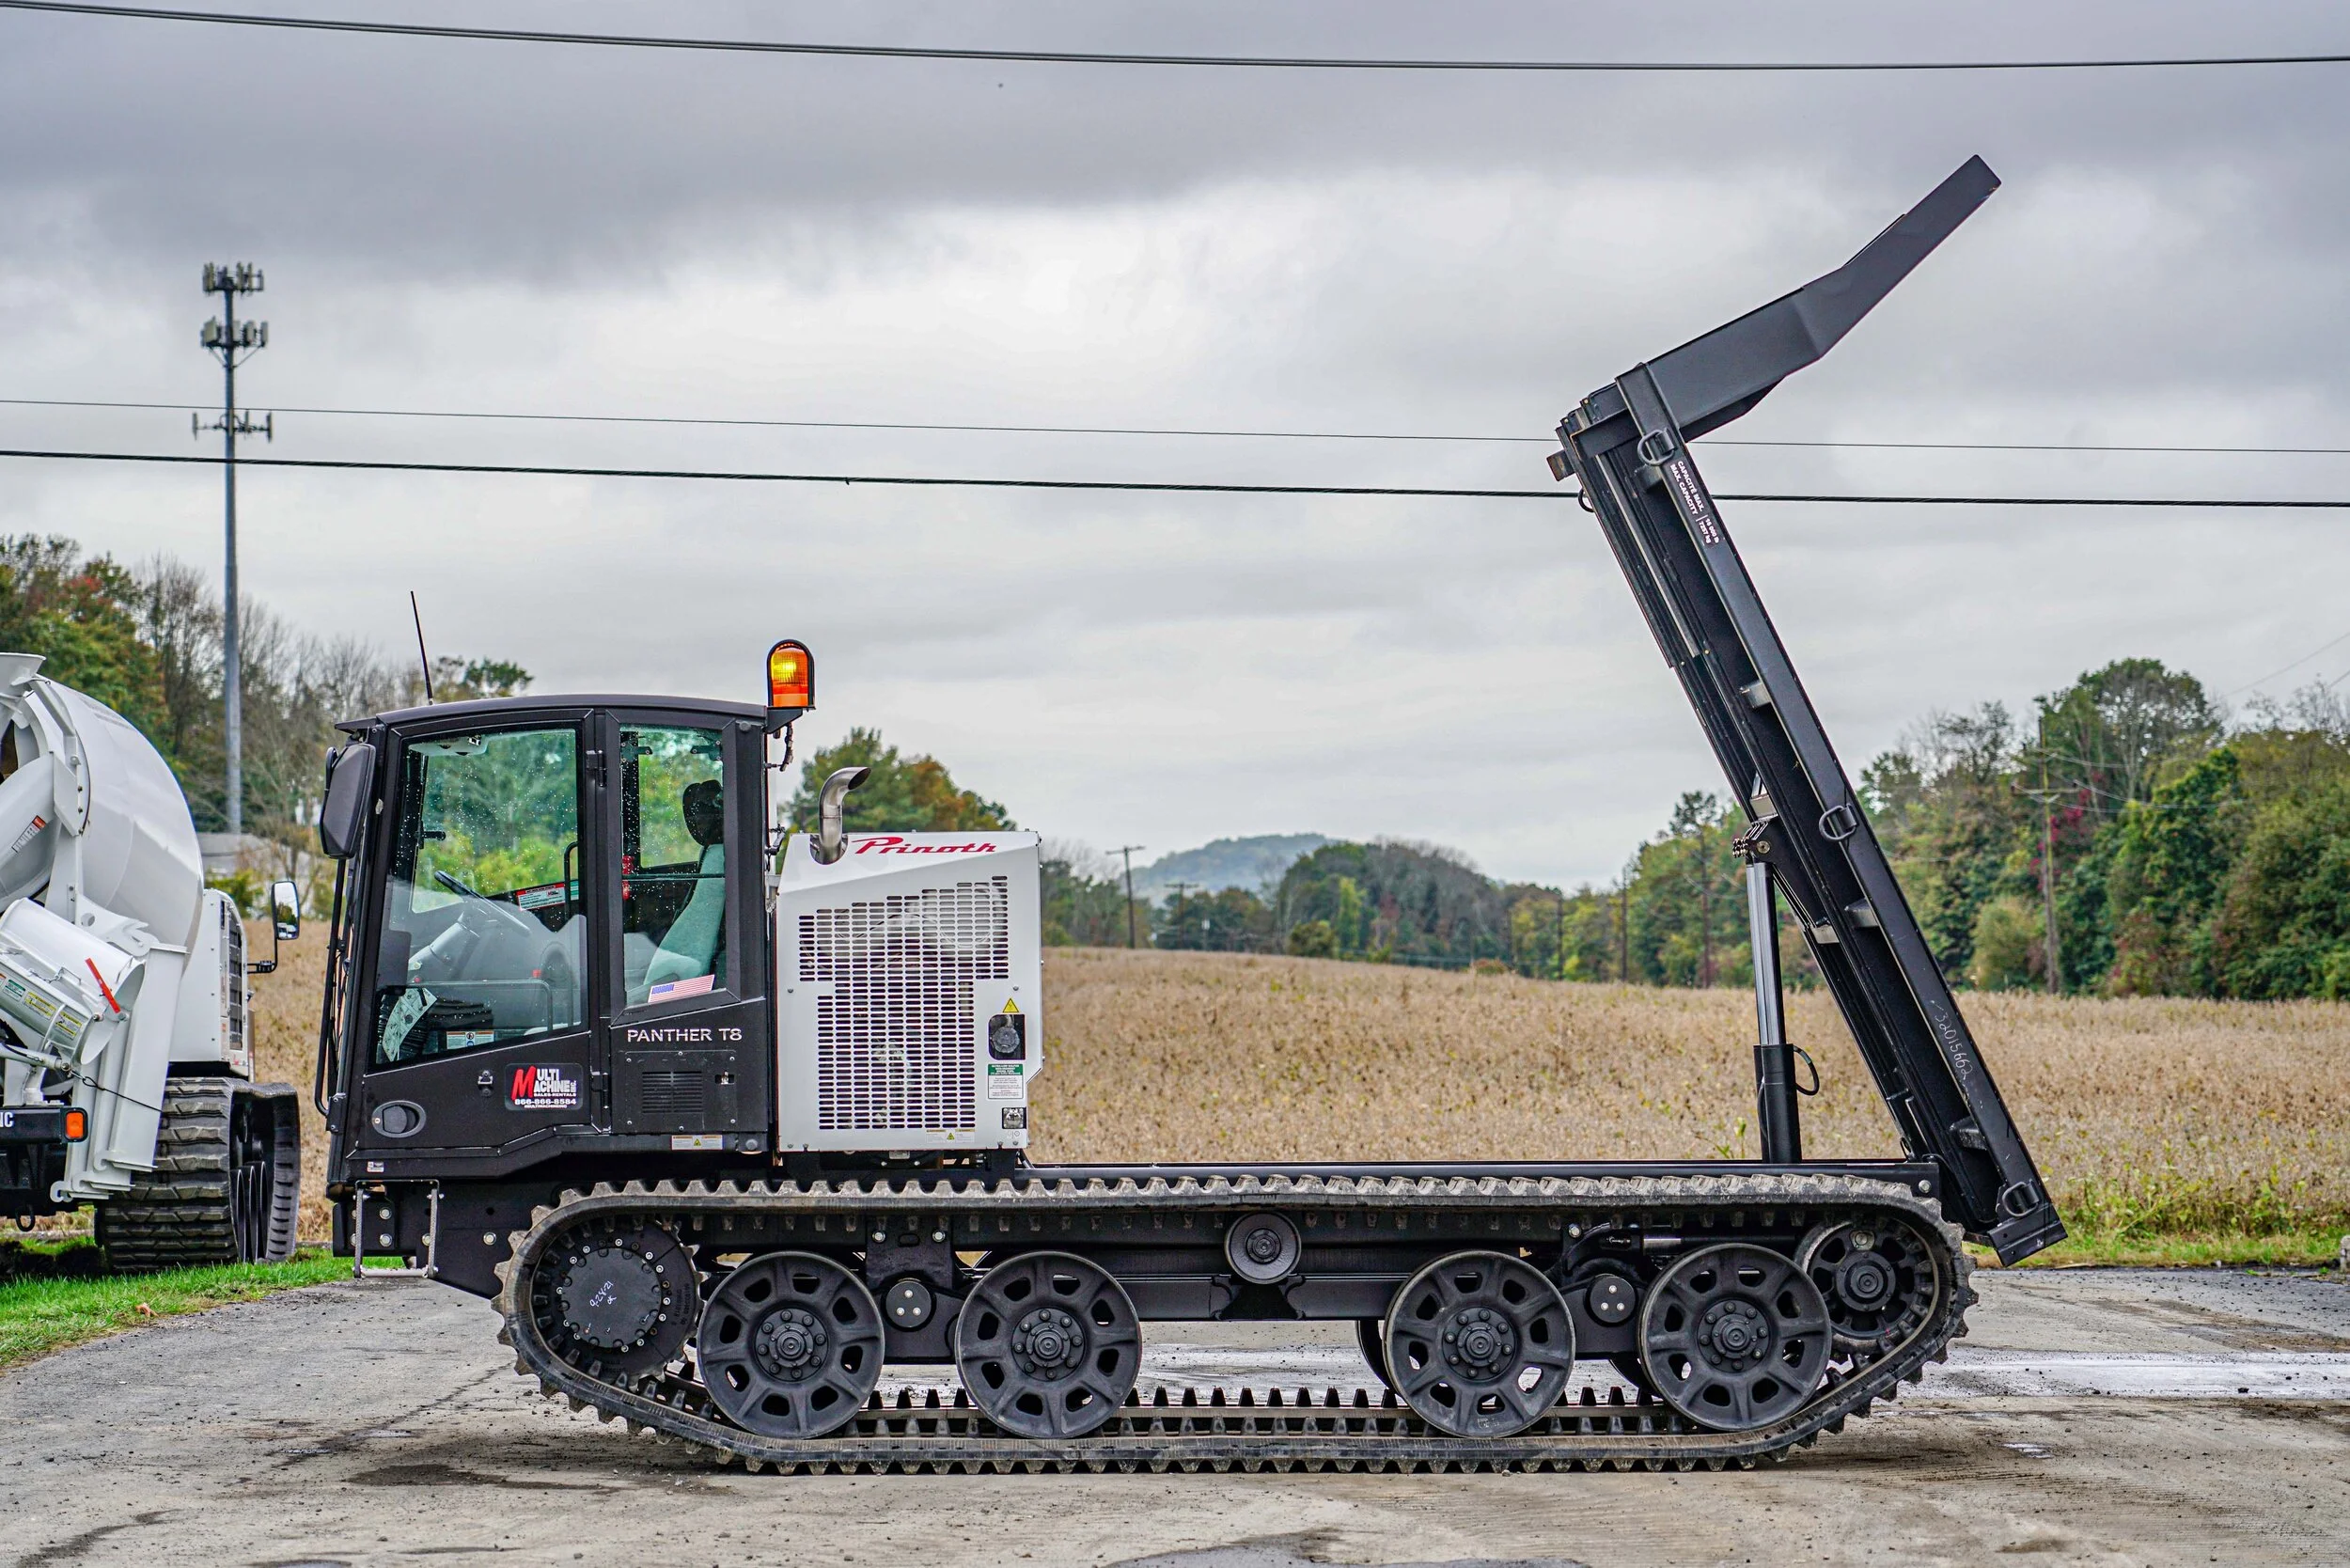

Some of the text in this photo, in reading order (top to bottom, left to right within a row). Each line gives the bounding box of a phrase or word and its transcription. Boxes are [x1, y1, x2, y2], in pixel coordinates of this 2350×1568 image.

[1679, 482, 1698, 514] CAPACITY
[851, 837, 996, 855] Prinoth
[627, 1027, 743, 1043] PANTHER T8
